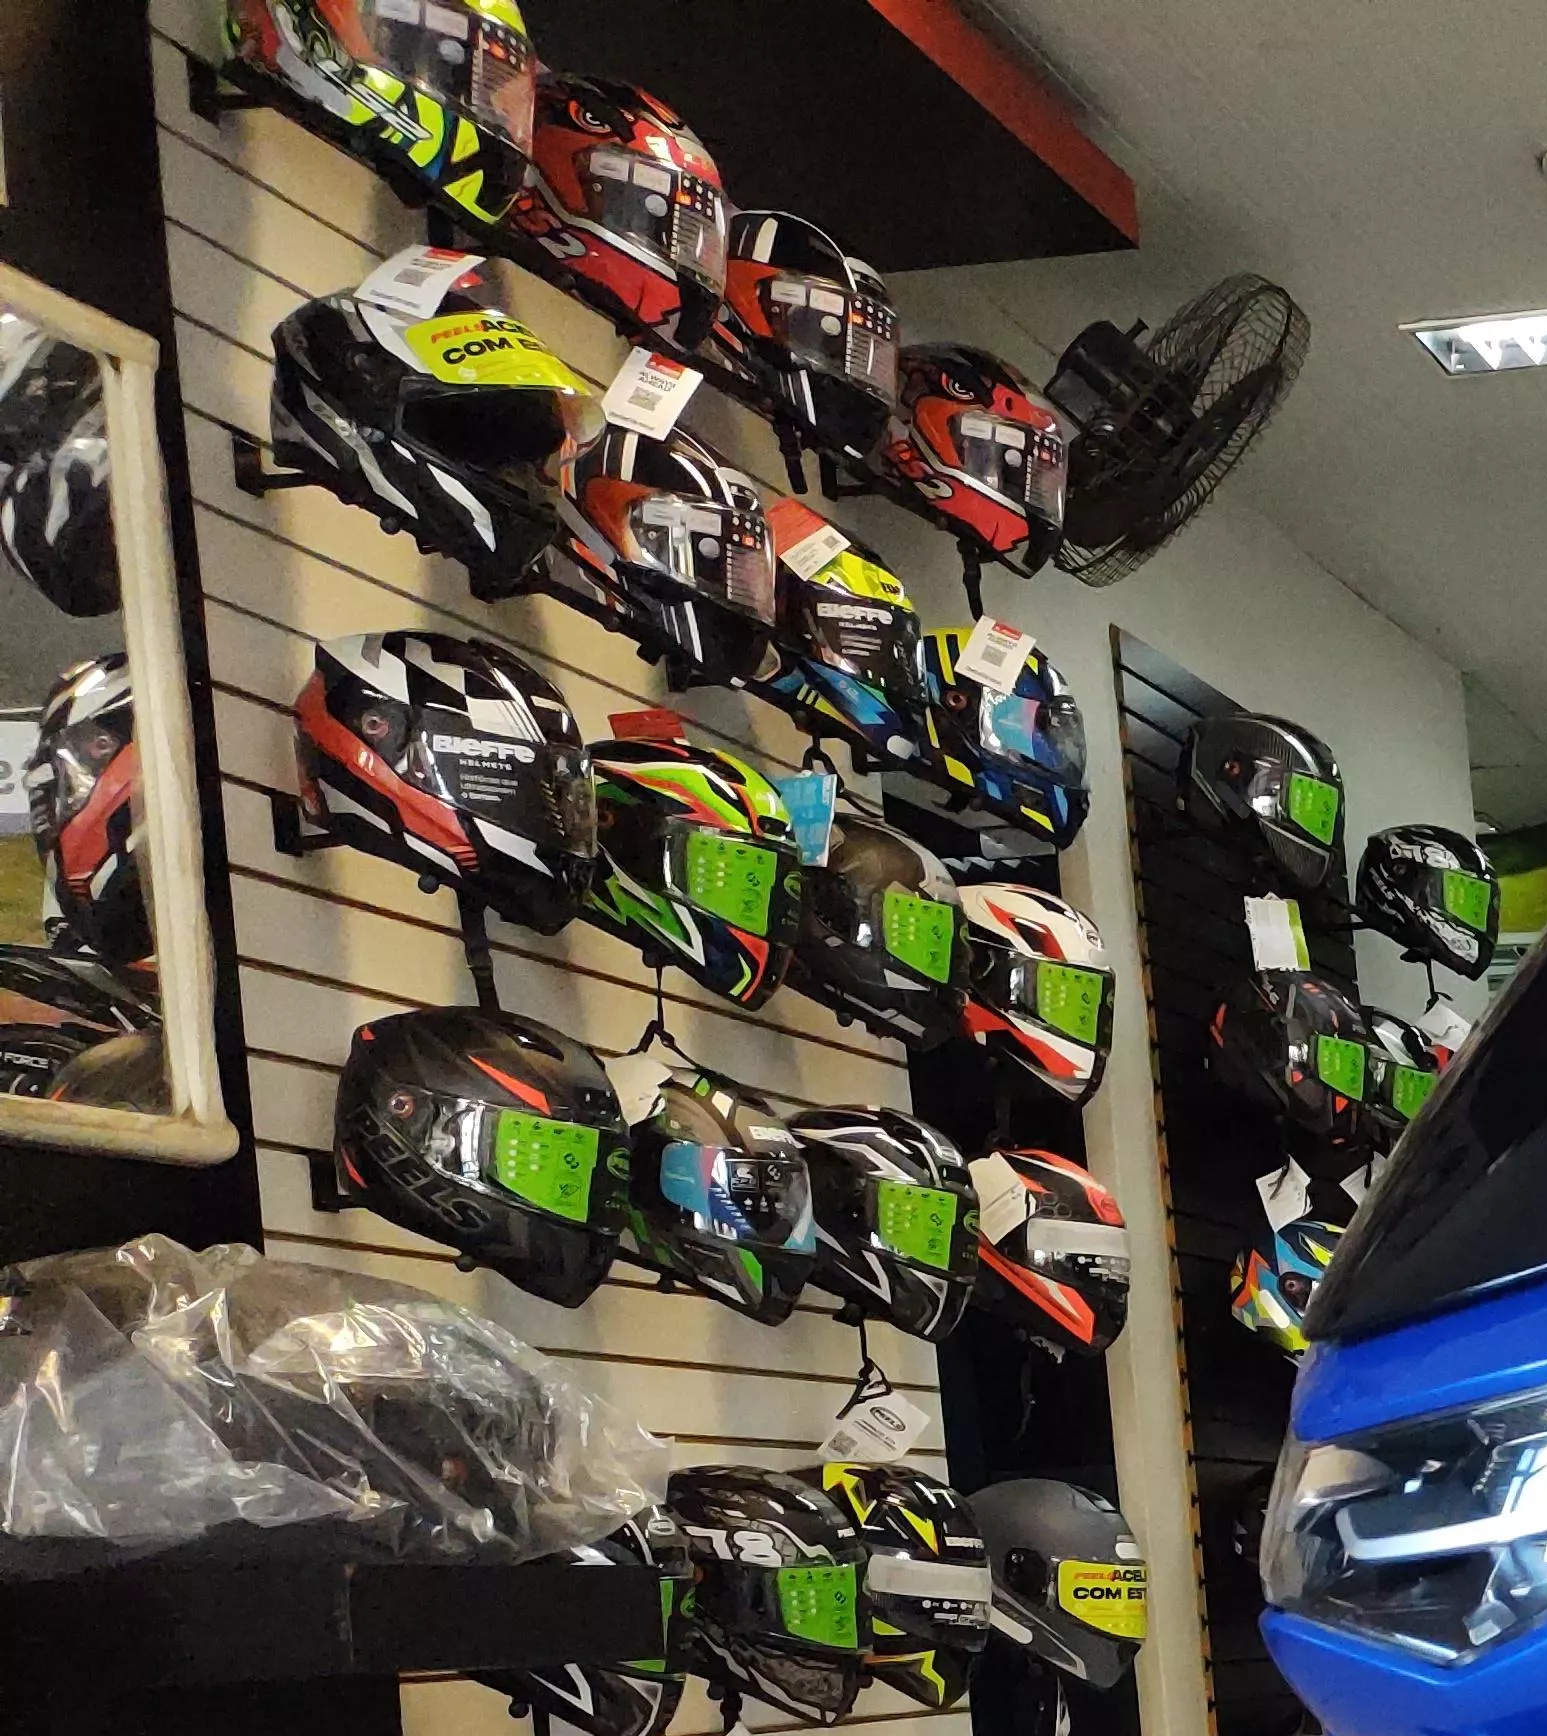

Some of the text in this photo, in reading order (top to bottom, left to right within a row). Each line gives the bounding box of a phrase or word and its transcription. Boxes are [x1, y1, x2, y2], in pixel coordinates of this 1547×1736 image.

[442, 336, 511, 365] COM
[682, 1525, 782, 1567] 78
[1073, 1586, 1122, 1600] COM
